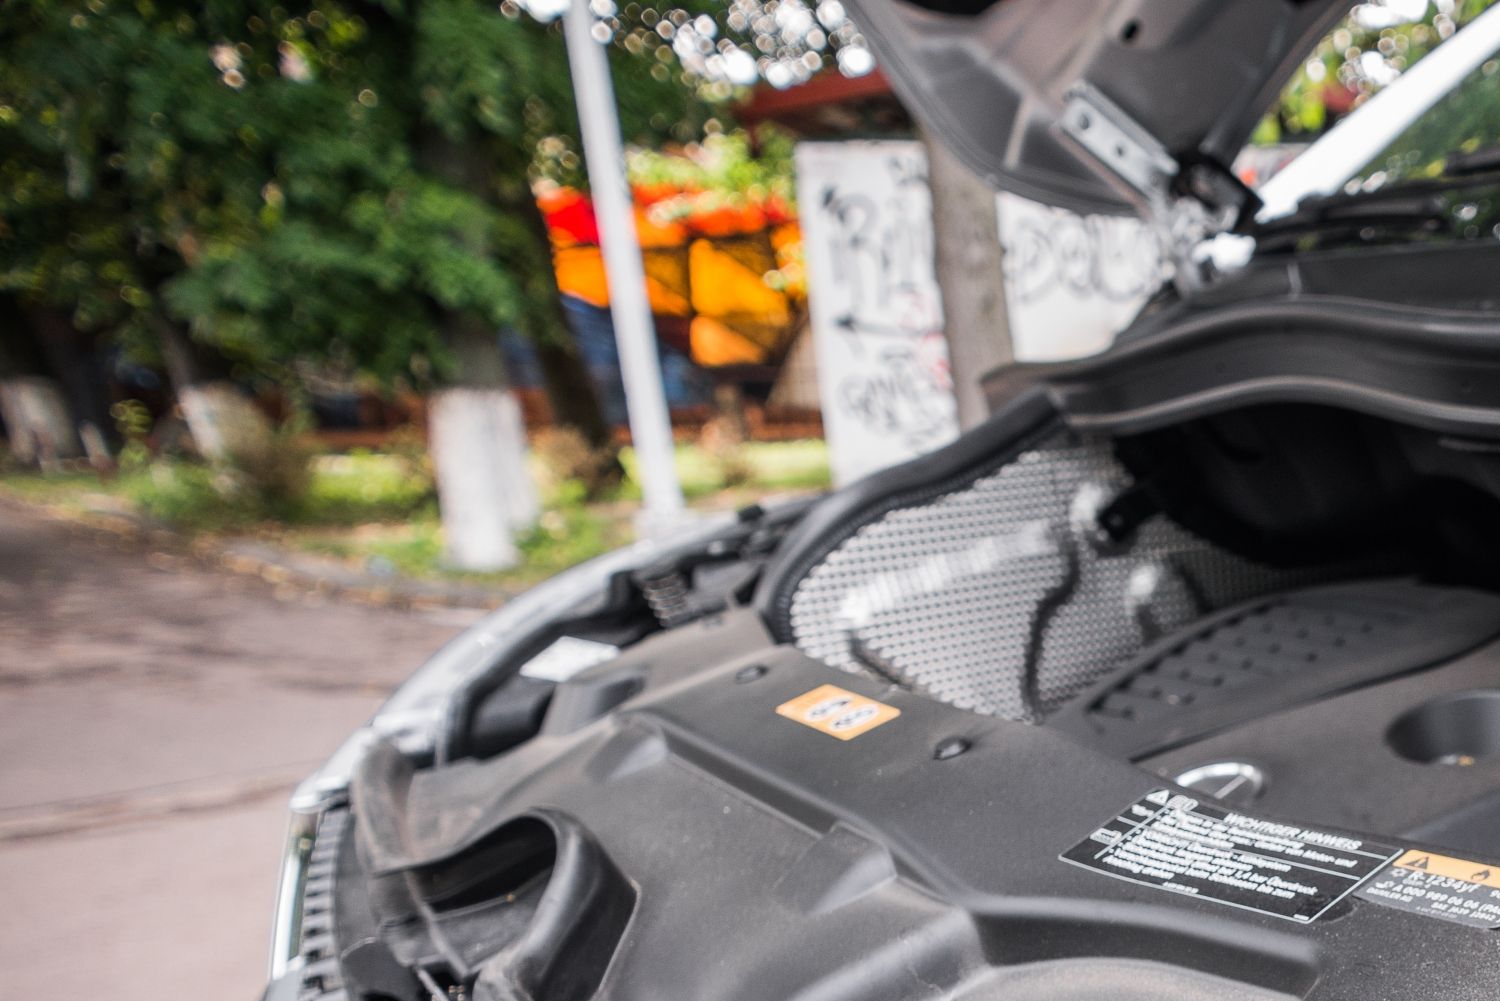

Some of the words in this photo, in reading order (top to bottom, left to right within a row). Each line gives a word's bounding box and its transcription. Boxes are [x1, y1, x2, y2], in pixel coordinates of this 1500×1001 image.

[1223, 812, 1301, 838] WICHTIGER
[1296, 830, 1362, 850] HINWEIS
[1403, 886, 1426, 897] 000
[1407, 870, 1481, 893] R-1234yf
